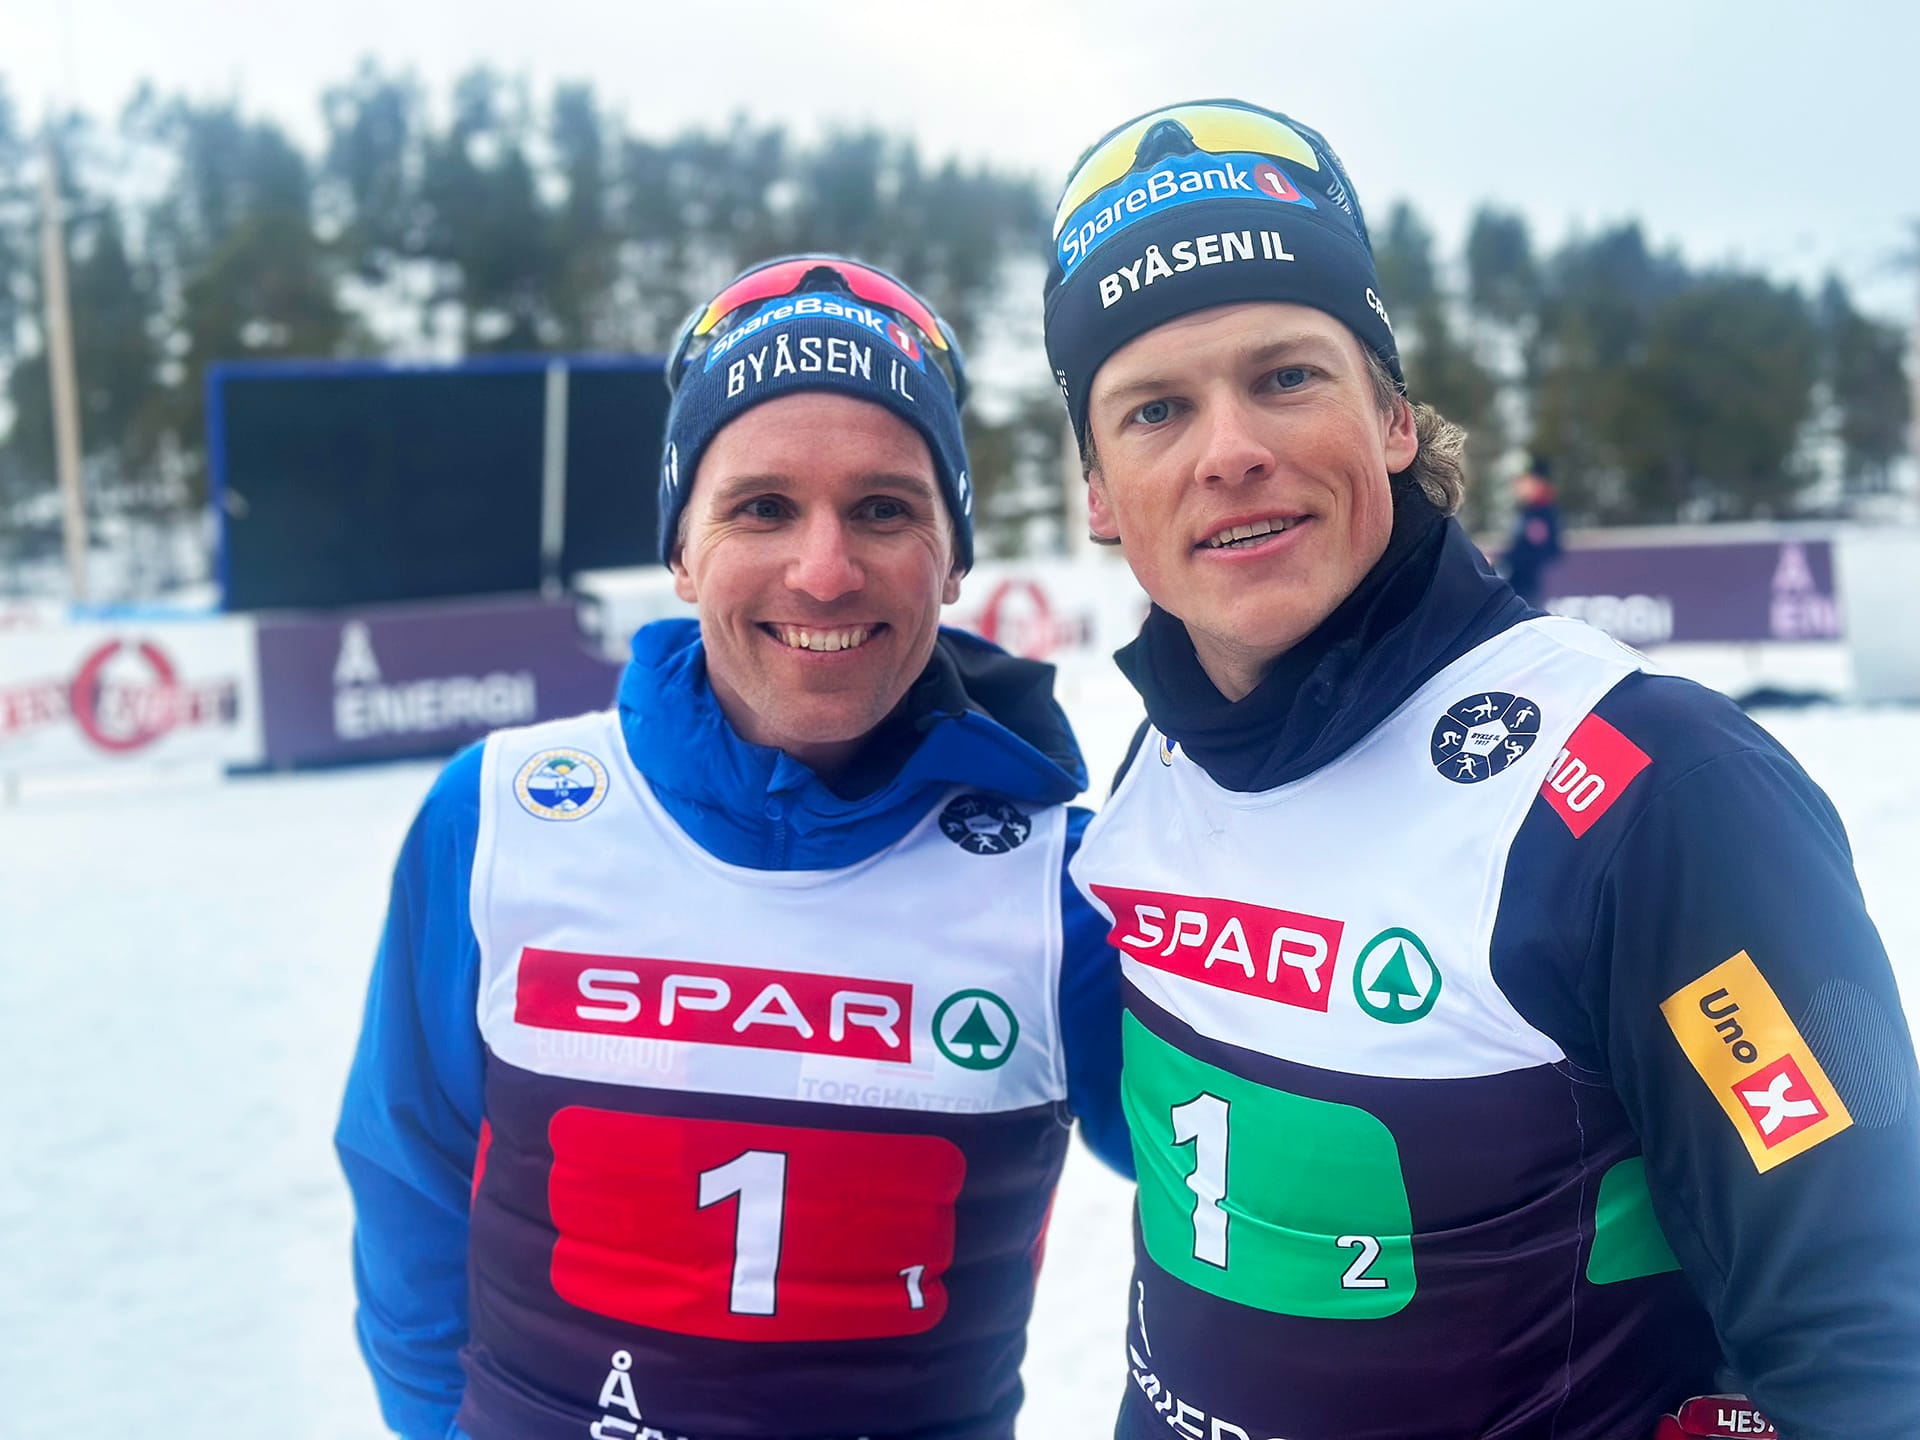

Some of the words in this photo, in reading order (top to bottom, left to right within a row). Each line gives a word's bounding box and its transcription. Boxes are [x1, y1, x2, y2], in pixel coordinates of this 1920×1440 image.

[1062, 162, 1253, 266] SpareBank
[1264, 172, 1286, 194] 1
[1099, 231, 1254, 309] BYÅSEN
[1261, 231, 1295, 262] IL
[711, 298, 883, 361] SpareBank
[894, 329, 910, 351] 1
[727, 333, 871, 398] BYÅSEN
[891, 359, 914, 402] IL
[333, 620, 380, 684] Å
[334, 670, 537, 740] ENERGI
[1121, 904, 1328, 993] SPAR
[576, 968, 901, 1048] SPAR
[1699, 987, 1758, 1064] Uno
[1171, 1090, 1231, 1271] 1
[1335, 1234, 1389, 1289] 2
[697, 1149, 788, 1317] 1
[899, 1265, 926, 1310] 1
[598, 1350, 642, 1420] Å
